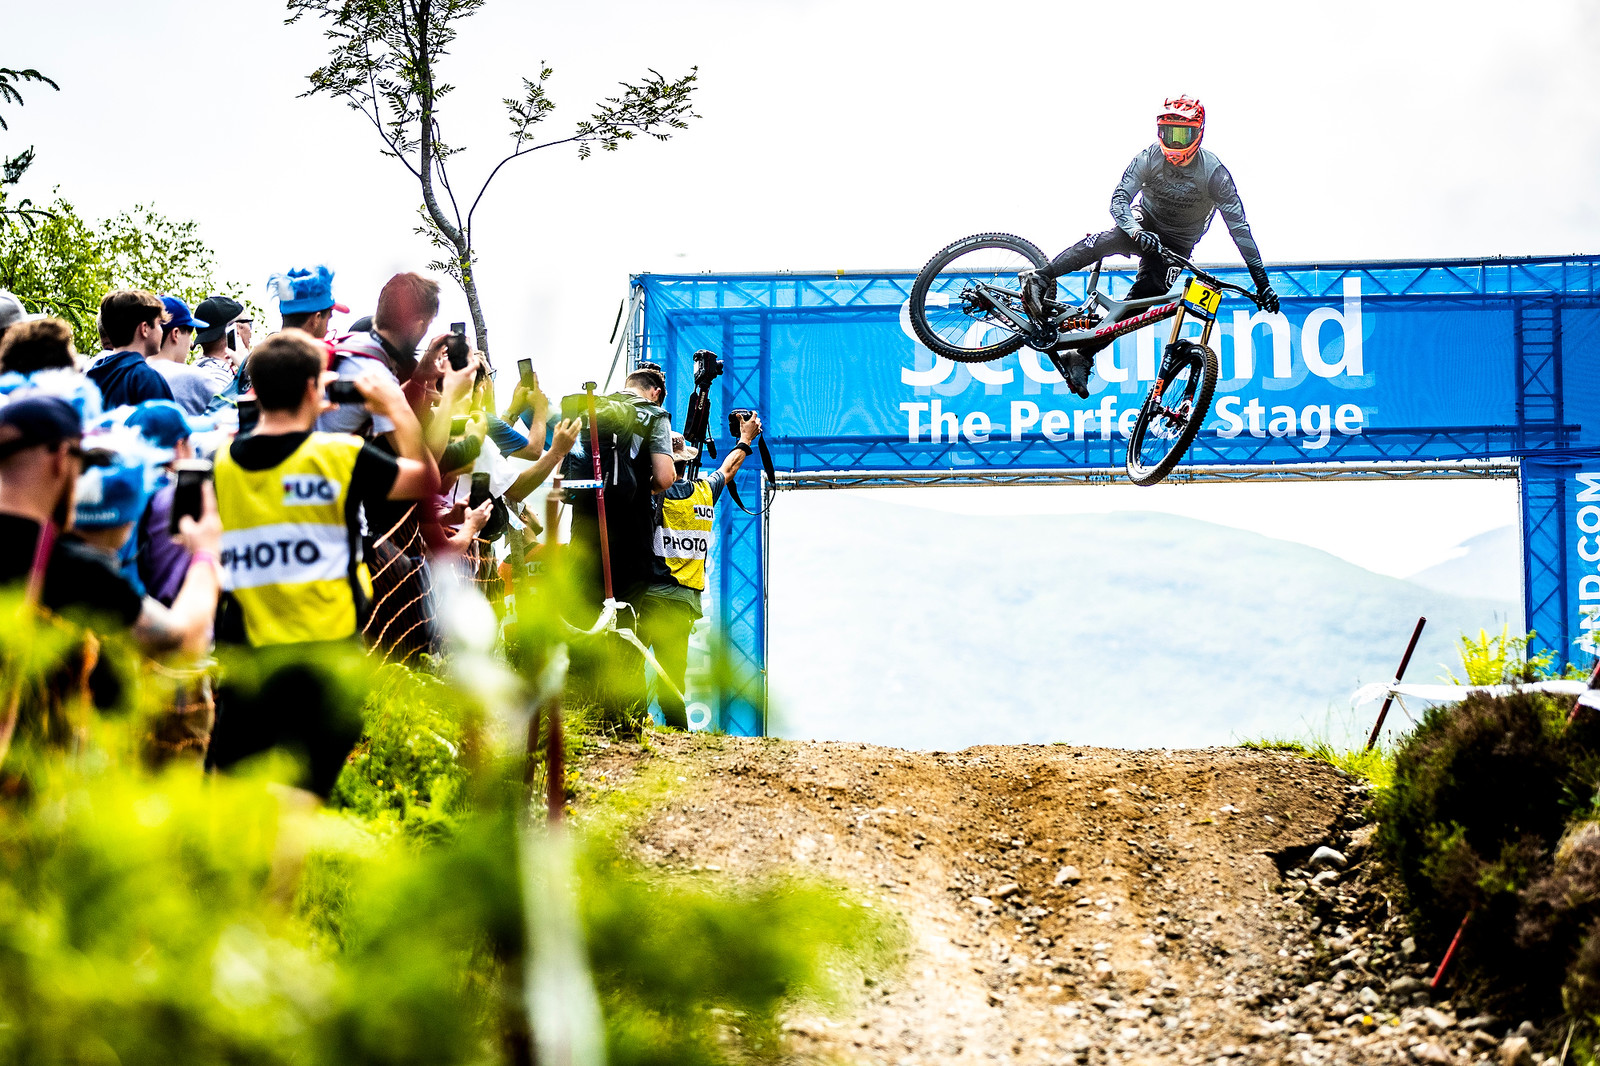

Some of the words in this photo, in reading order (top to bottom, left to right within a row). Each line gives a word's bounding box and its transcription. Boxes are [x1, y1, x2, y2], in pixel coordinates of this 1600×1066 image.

[1199, 289, 1210, 307] 2
[1095, 316, 1140, 338] SANTA
[1141, 301, 1177, 321] CRUZ
[899, 399, 992, 444] The
[1010, 395, 1176, 443] Perfec
[1215, 396, 1365, 450] Stage
[698, 507, 714, 519] UCI
[220, 538, 320, 572] PHOTO
[662, 535, 708, 552] PHOTO
